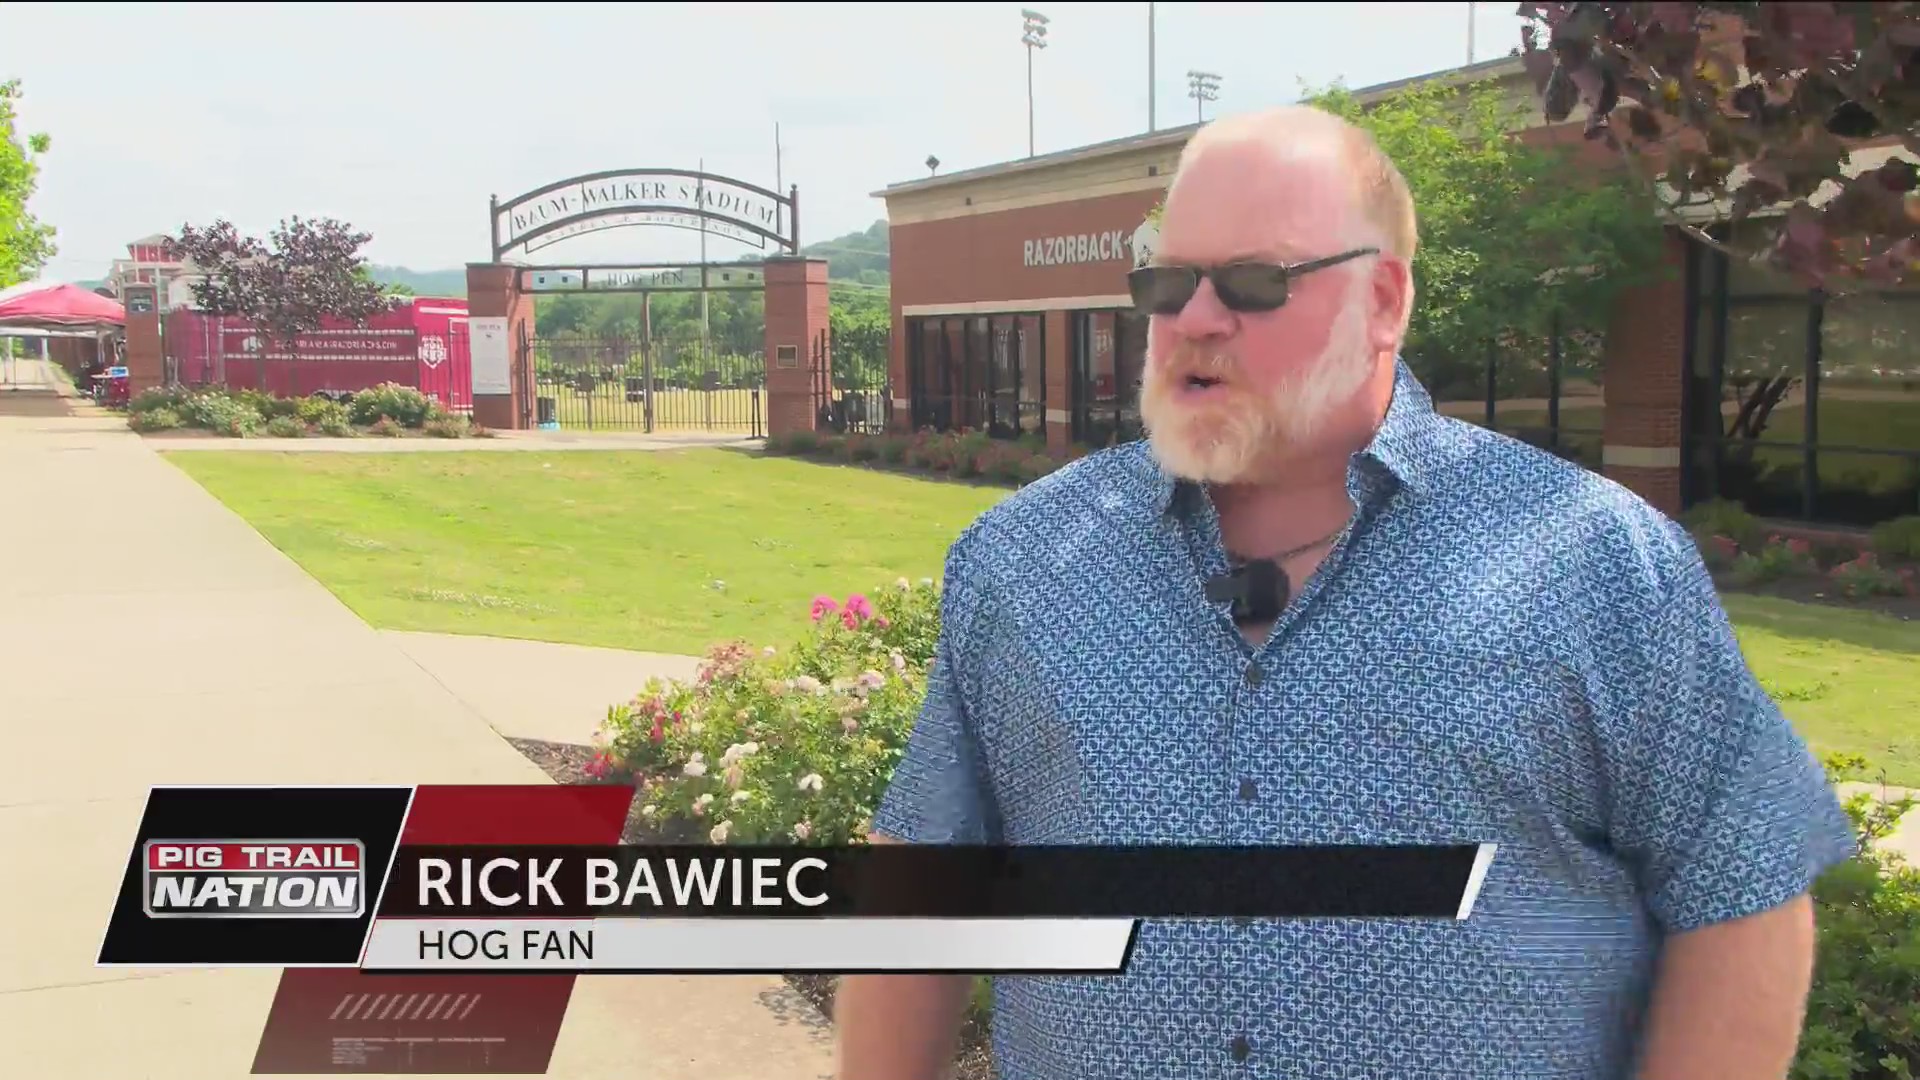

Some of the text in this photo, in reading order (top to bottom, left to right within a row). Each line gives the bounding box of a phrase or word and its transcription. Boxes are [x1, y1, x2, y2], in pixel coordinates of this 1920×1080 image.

[514, 183, 667, 230] BAUM-WALKER
[679, 184, 775, 224] STADIUM
[1024, 230, 1124, 266] RAZORBACK
[607, 270, 684, 286] HOG PEN
